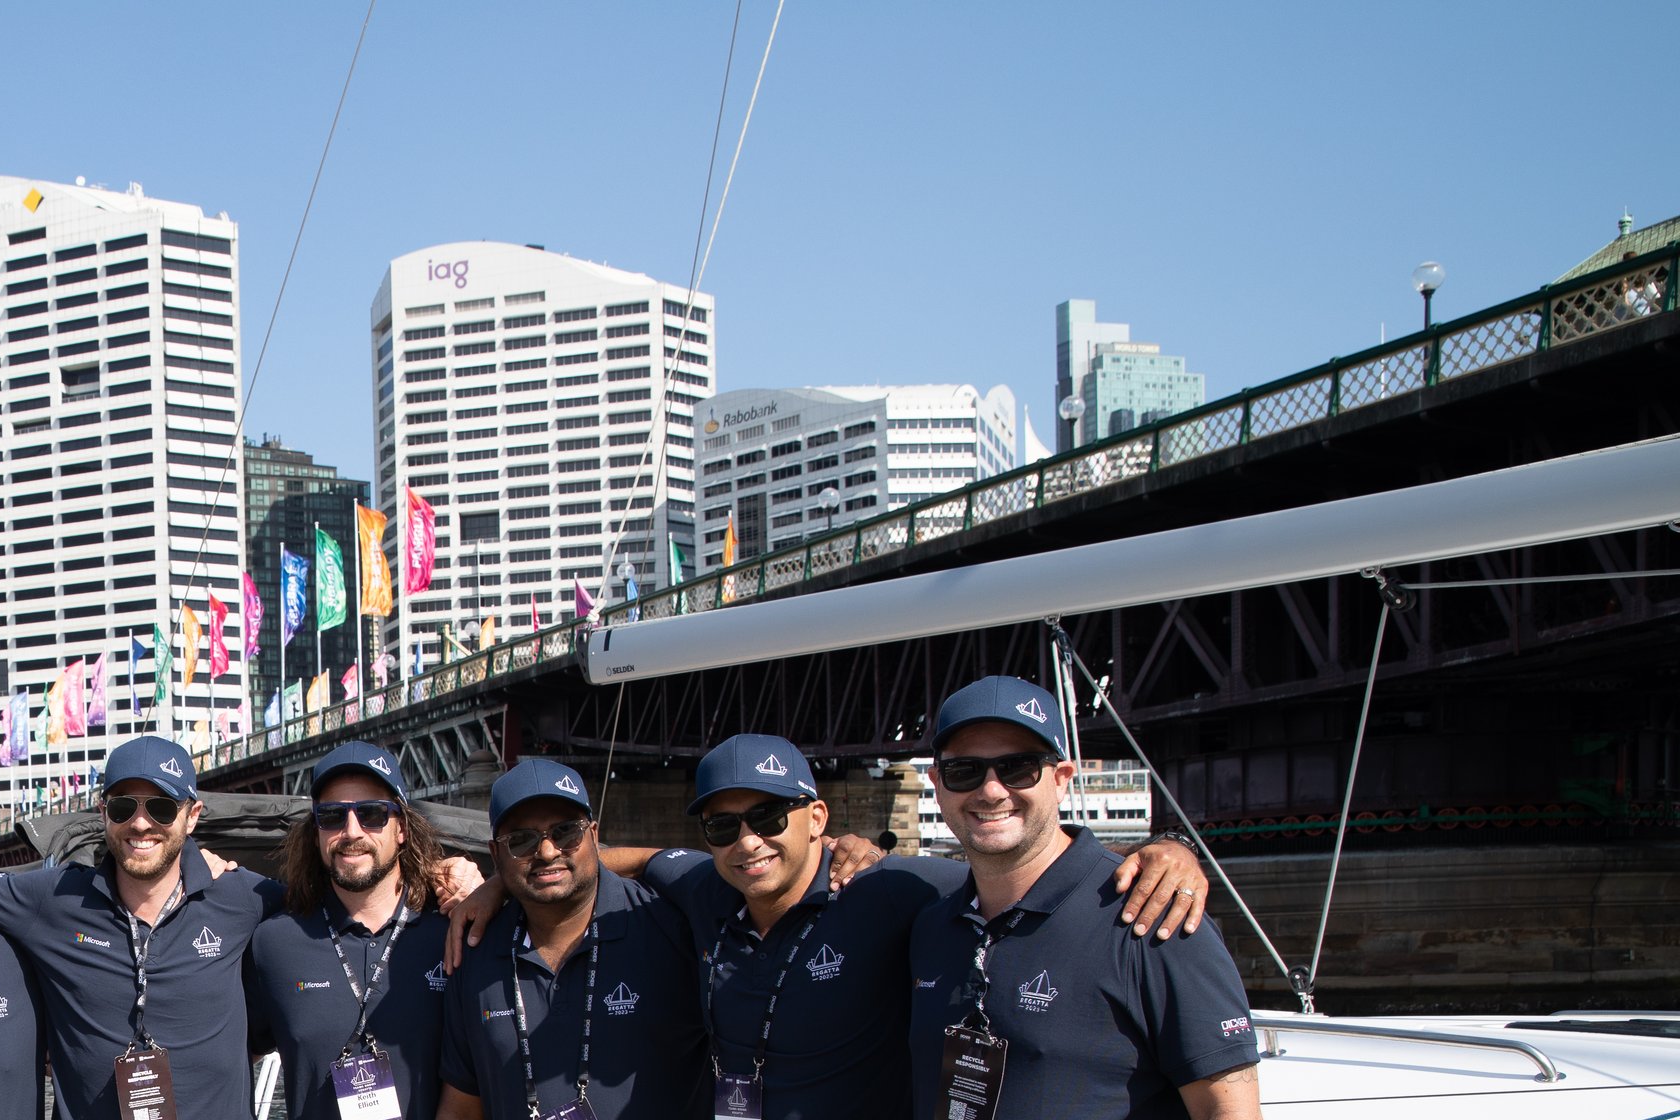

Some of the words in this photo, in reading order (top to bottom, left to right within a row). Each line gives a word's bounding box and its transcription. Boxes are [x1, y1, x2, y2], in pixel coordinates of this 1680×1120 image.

[428, 259, 469, 290] iag
[723, 400, 777, 428] Rabobank
[84, 935, 110, 949] Microsoft
[811, 966, 840, 977] REGATTA
[819, 973, 833, 981] 2023
[304, 980, 330, 989] Microsoft
[1020, 997, 1049, 1007] REGATTA
[490, 1008, 515, 1018] Microsoft
[607, 1004, 635, 1012] REGATTA
[1220, 1017, 1249, 1032] DICKER
[961, 1054, 985, 1065] RECYCLE
[955, 1059, 990, 1073] RESPONSIBLY
[357, 1091, 377, 1101] Keith
[358, 1099, 380, 1109] Elliott
